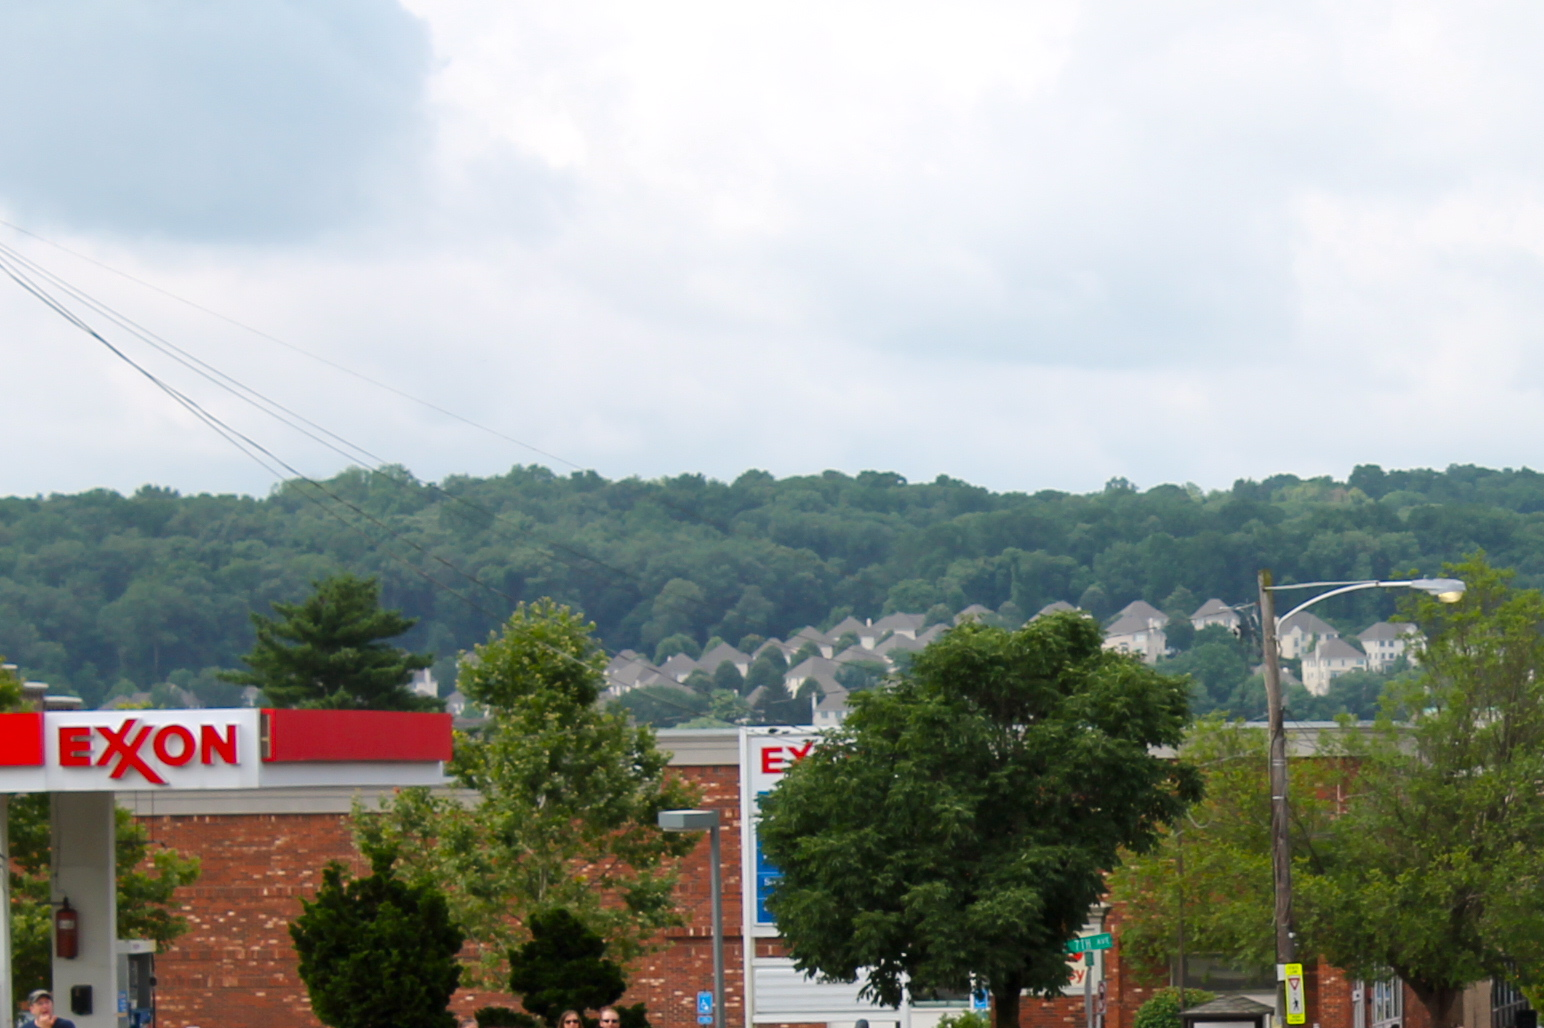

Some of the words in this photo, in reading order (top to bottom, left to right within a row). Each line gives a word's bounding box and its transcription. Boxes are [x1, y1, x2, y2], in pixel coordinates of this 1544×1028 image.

[58, 718, 238, 785] EXXON
[1074, 938, 1092, 951] 7TH
[1096, 936, 1110, 945] AVE
